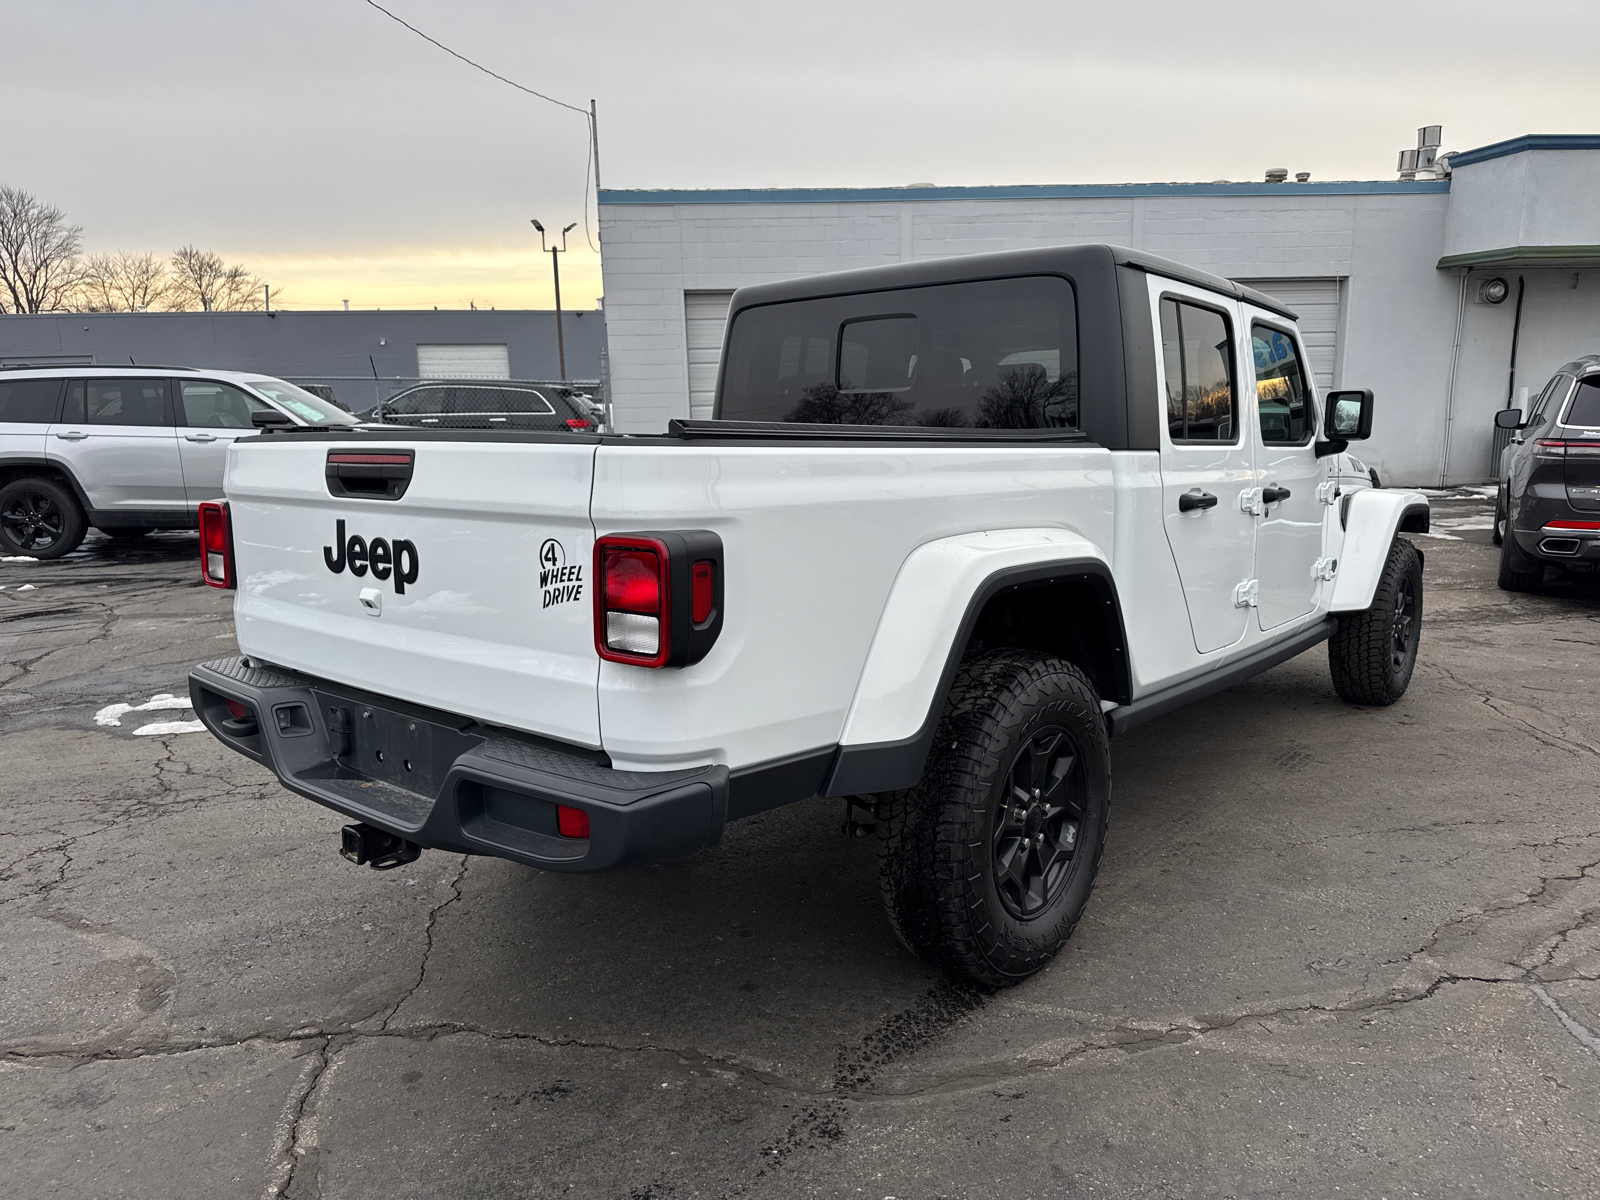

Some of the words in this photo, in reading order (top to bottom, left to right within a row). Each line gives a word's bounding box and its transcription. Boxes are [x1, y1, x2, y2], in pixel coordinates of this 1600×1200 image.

[323, 518, 419, 595] Jeep
[540, 565, 583, 589] WHEEL
[543, 584, 583, 609] DRIVE
